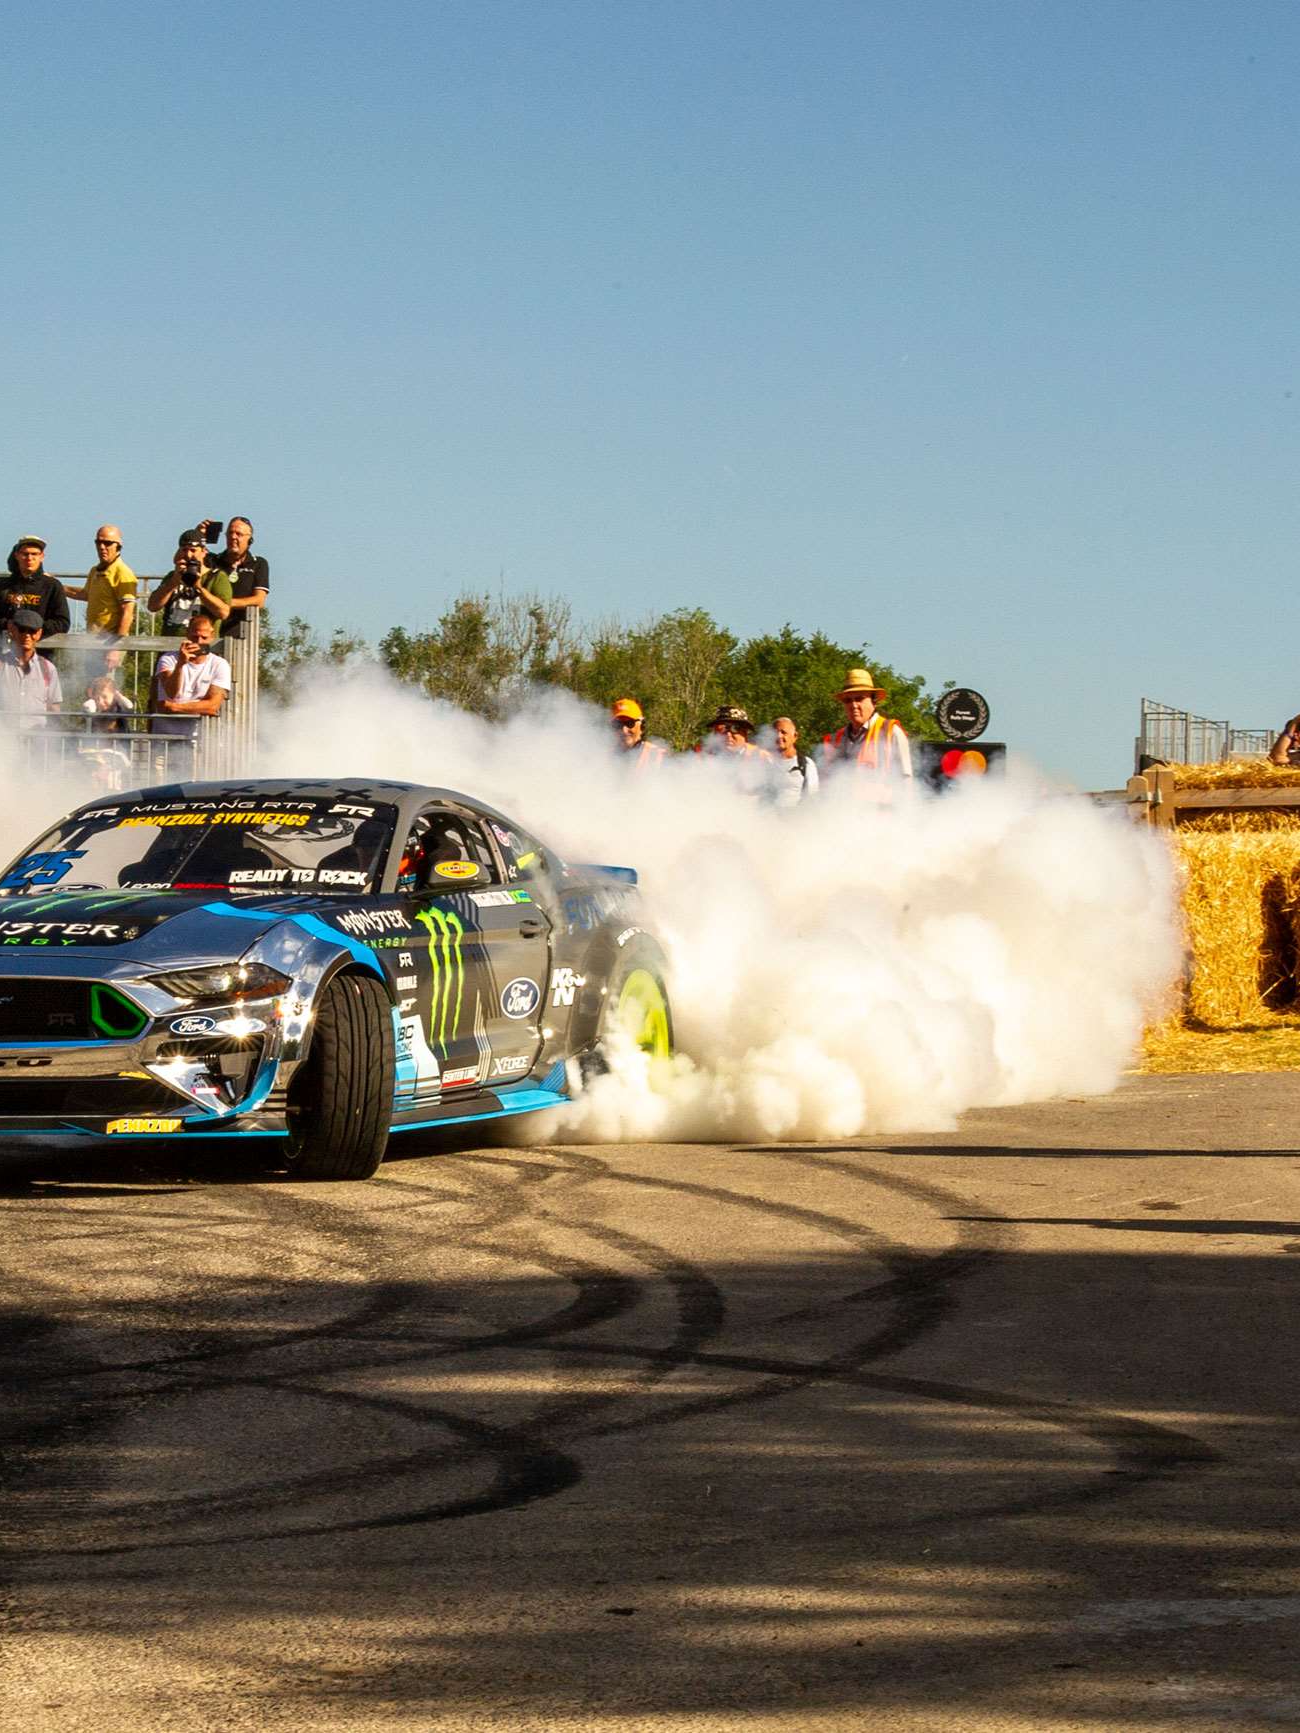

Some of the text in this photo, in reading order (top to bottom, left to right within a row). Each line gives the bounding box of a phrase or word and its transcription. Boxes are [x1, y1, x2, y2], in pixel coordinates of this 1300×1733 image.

[131, 801, 317, 813] MUSTANG RTR
[116, 812, 310, 829] PENNZOIL SYNTHETICS
[0, 850, 88, 889] 25
[228, 870, 367, 886] READY TO ROCK
[363, 936, 408, 949] ENERGY
[507, 983, 534, 1012] Ford
[178, 1018, 208, 1033] Ford
